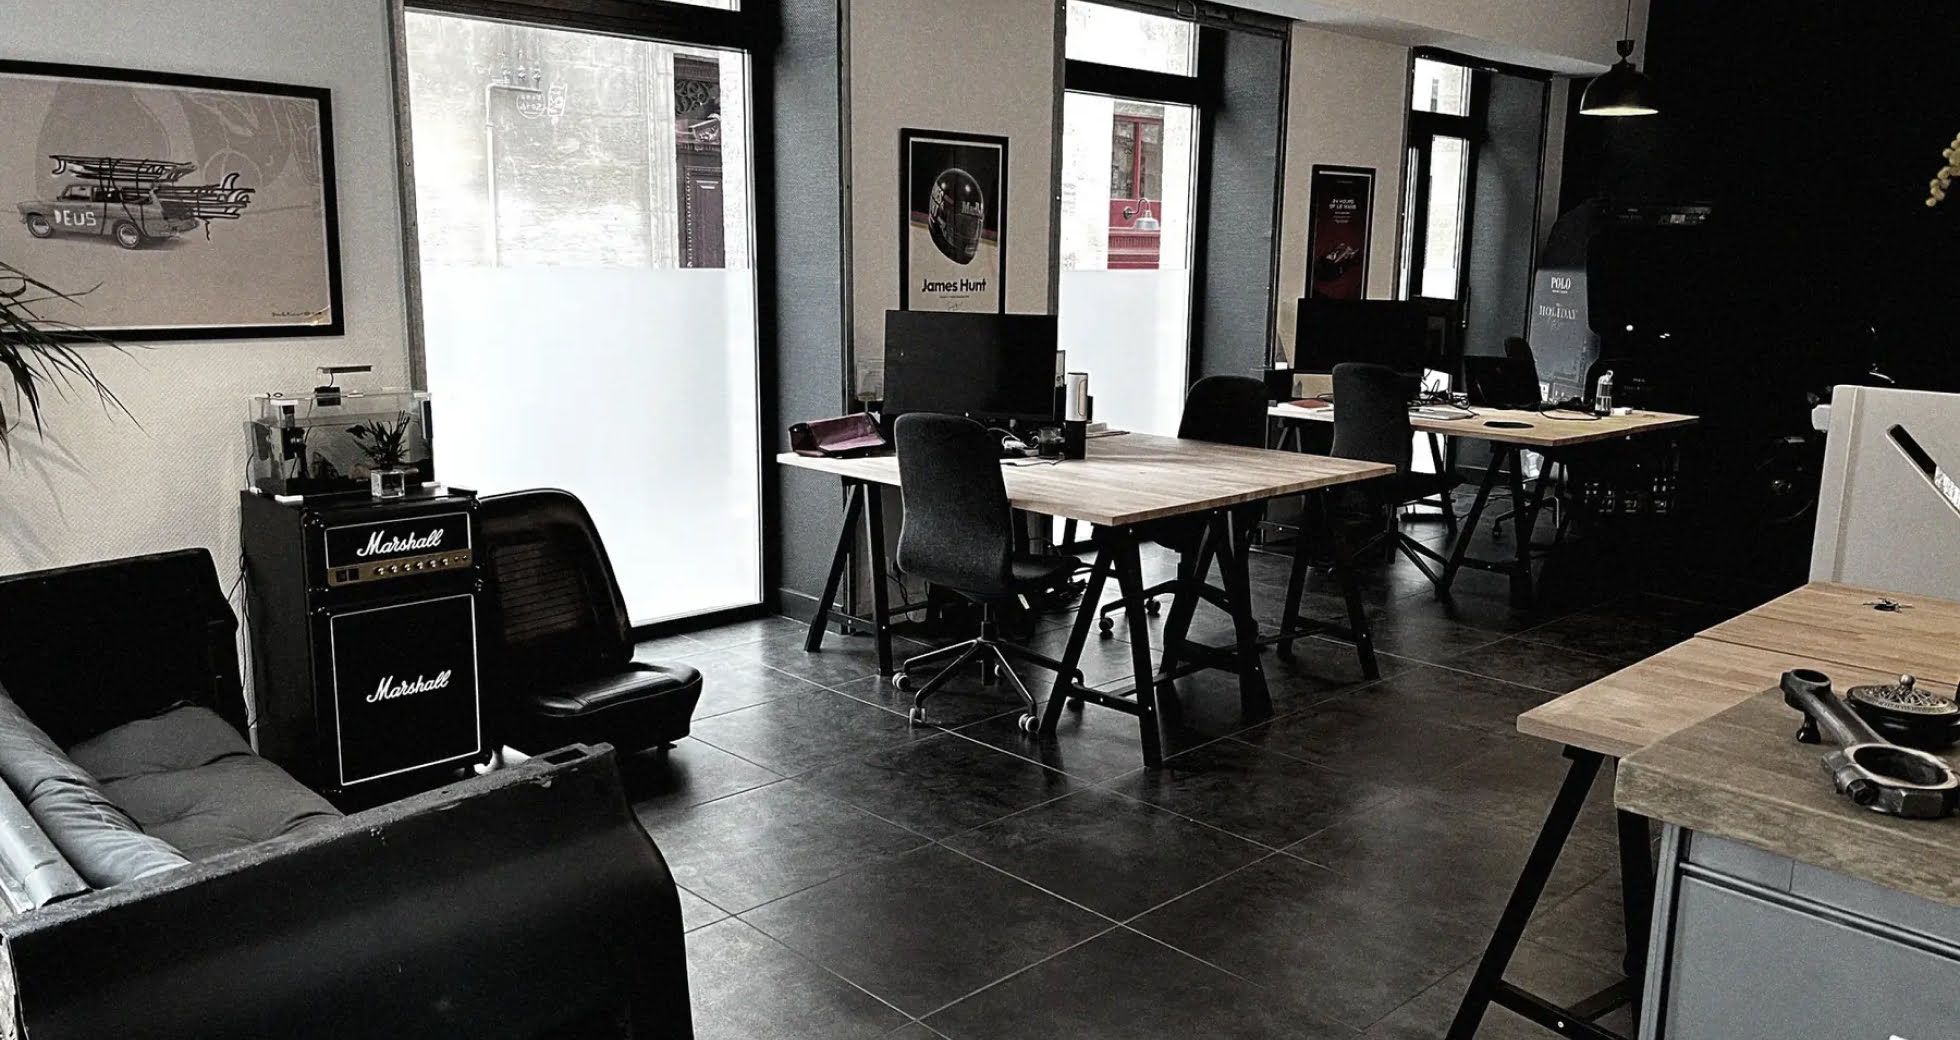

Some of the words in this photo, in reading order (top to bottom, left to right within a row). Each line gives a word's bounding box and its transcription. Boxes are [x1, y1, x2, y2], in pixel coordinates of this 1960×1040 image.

[54, 209, 97, 226] DEUS
[922, 279, 958, 292] James
[960, 278, 987, 292] Hunt
[1551, 276, 1571, 290] POLO
[1539, 304, 1578, 320] HOLIDAY
[356, 528, 444, 557] Marshall
[366, 669, 452, 703] Marshall
